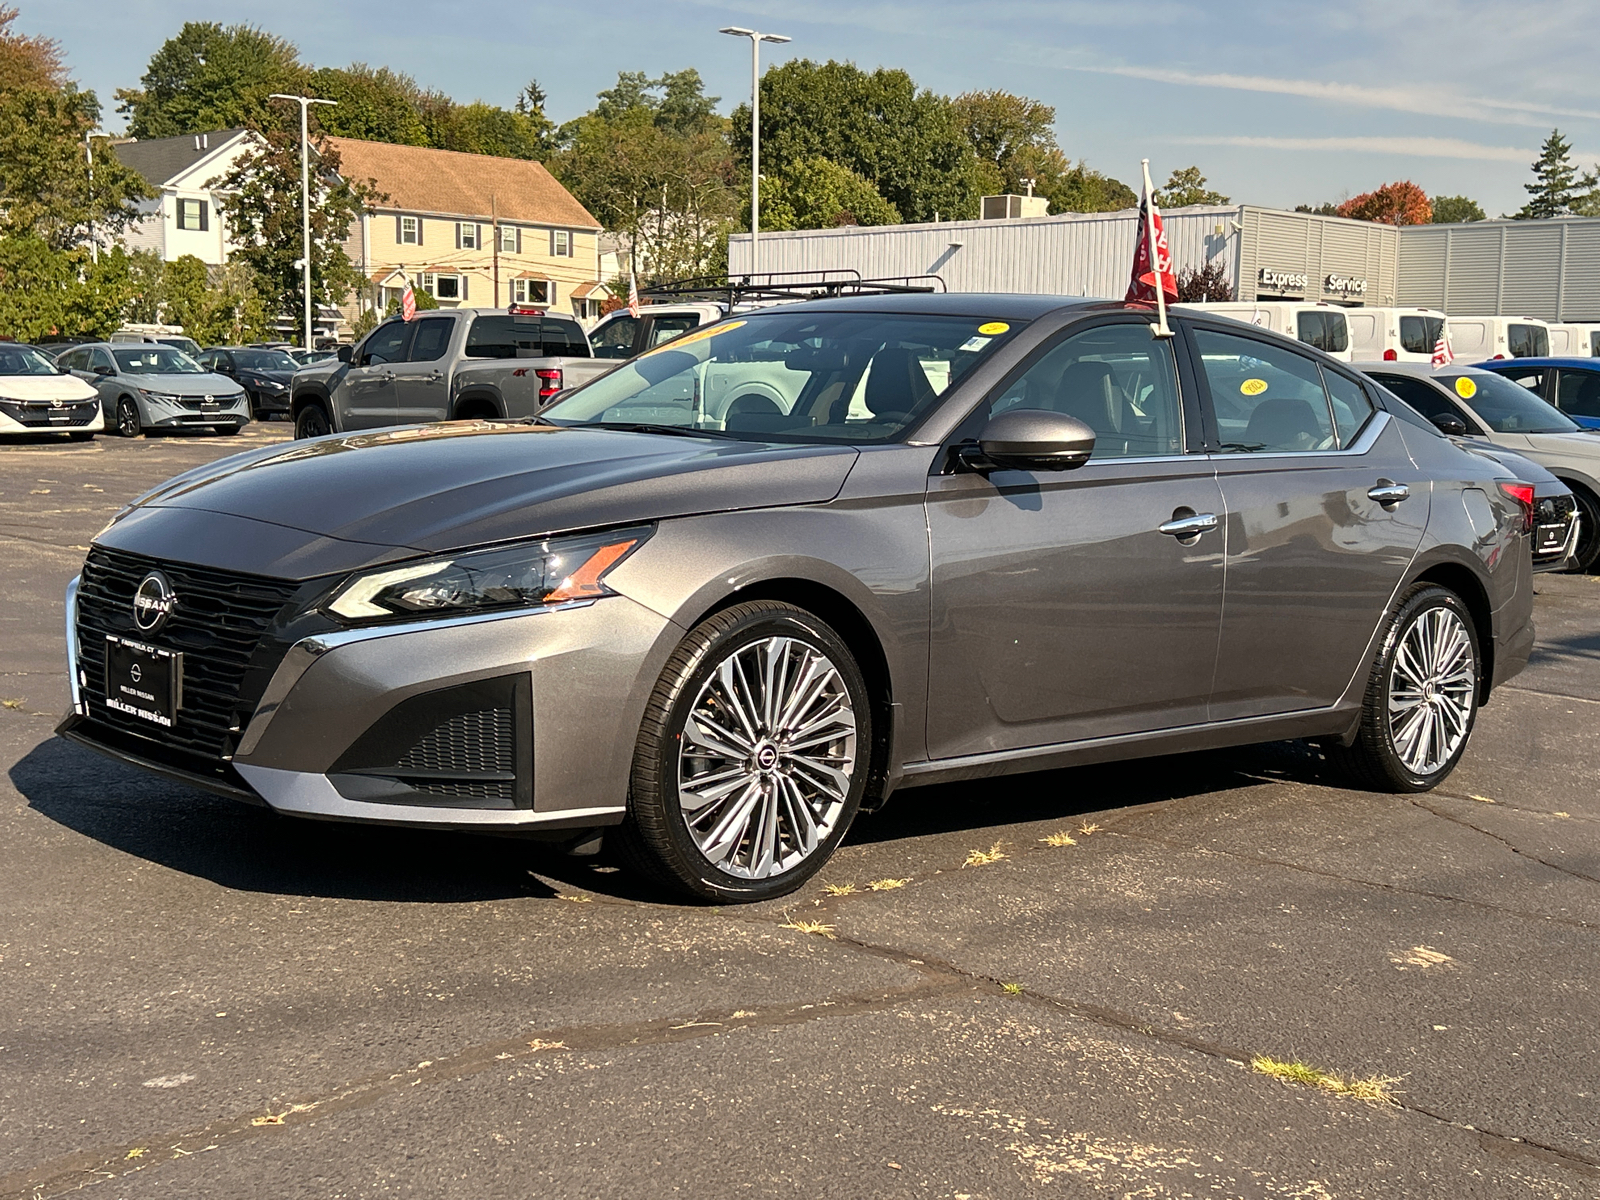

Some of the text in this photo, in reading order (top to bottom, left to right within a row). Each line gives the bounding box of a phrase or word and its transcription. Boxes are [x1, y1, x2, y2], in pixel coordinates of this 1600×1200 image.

[1263, 269, 1367, 292] Express Service
[106, 698, 172, 727] MILLER NISSAN
